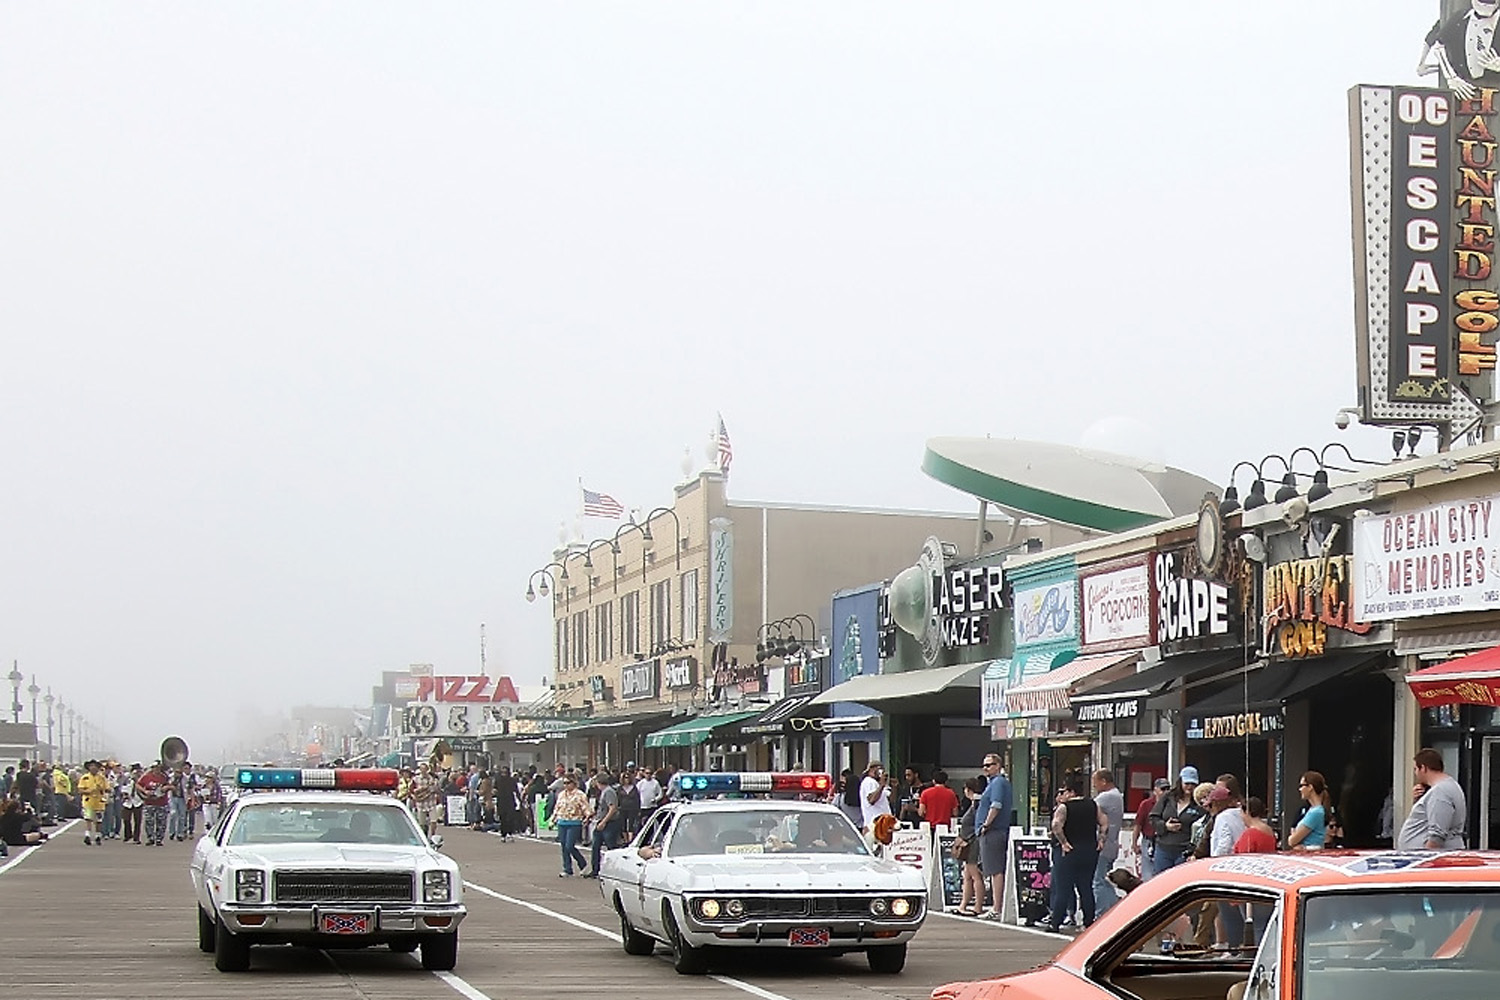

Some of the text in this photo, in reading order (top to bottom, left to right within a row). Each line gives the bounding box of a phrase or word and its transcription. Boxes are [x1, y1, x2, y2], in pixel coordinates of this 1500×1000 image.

[1399, 94, 1449, 378] OC ESCAPE
[1453, 87, 1500, 376] HAUNTED GOLF
[1383, 500, 1492, 553] OCEAN CITY
[1155, 552, 1174, 592] OC
[1388, 547, 1486, 596] MEMORIES
[1101, 594, 1148, 624] POPCORN
[1158, 577, 1228, 643] SCAPE
[1280, 622, 1327, 658] GOLF
[416, 676, 519, 702] PIZZA
